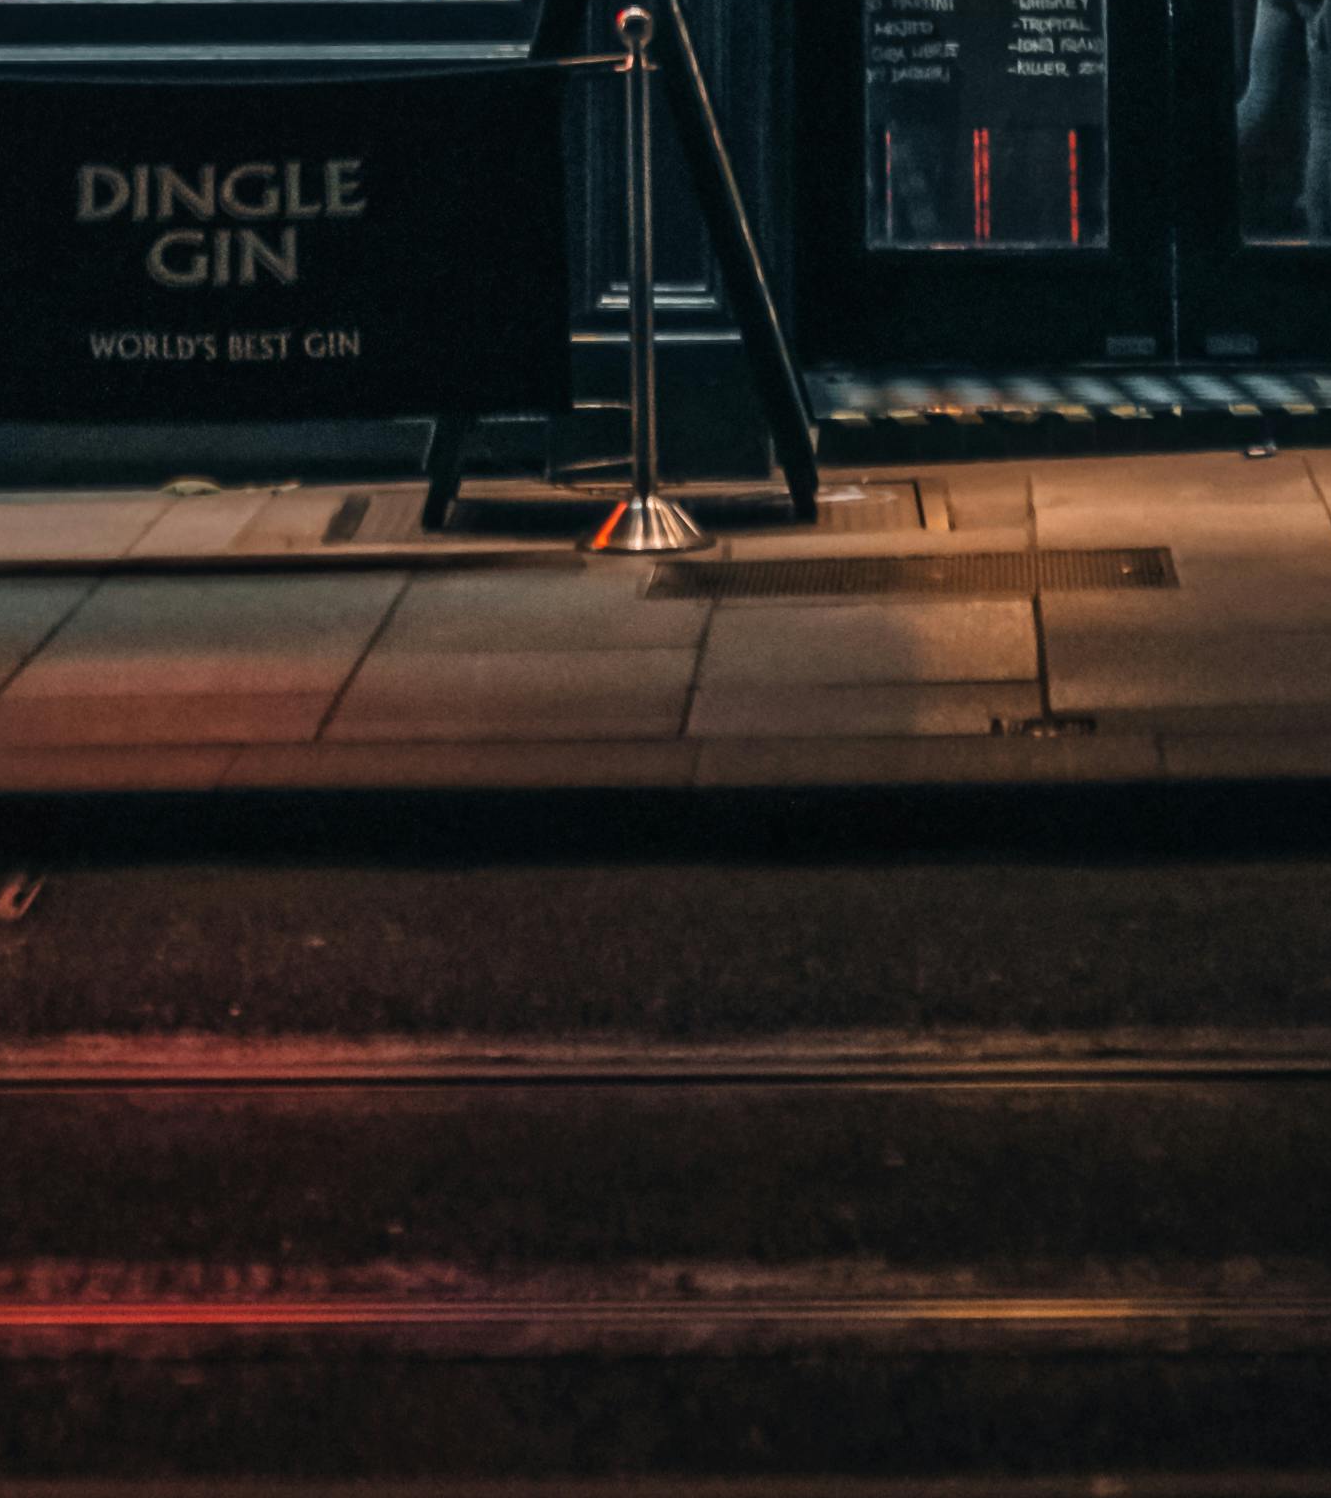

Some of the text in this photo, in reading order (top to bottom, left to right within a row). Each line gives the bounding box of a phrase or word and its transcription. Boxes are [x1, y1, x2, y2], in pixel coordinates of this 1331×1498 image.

[74, 157, 368, 223] DINGLE
[145, 225, 299, 288] GIN
[88, 327, 363, 363] WORLD'S BEST GIN
